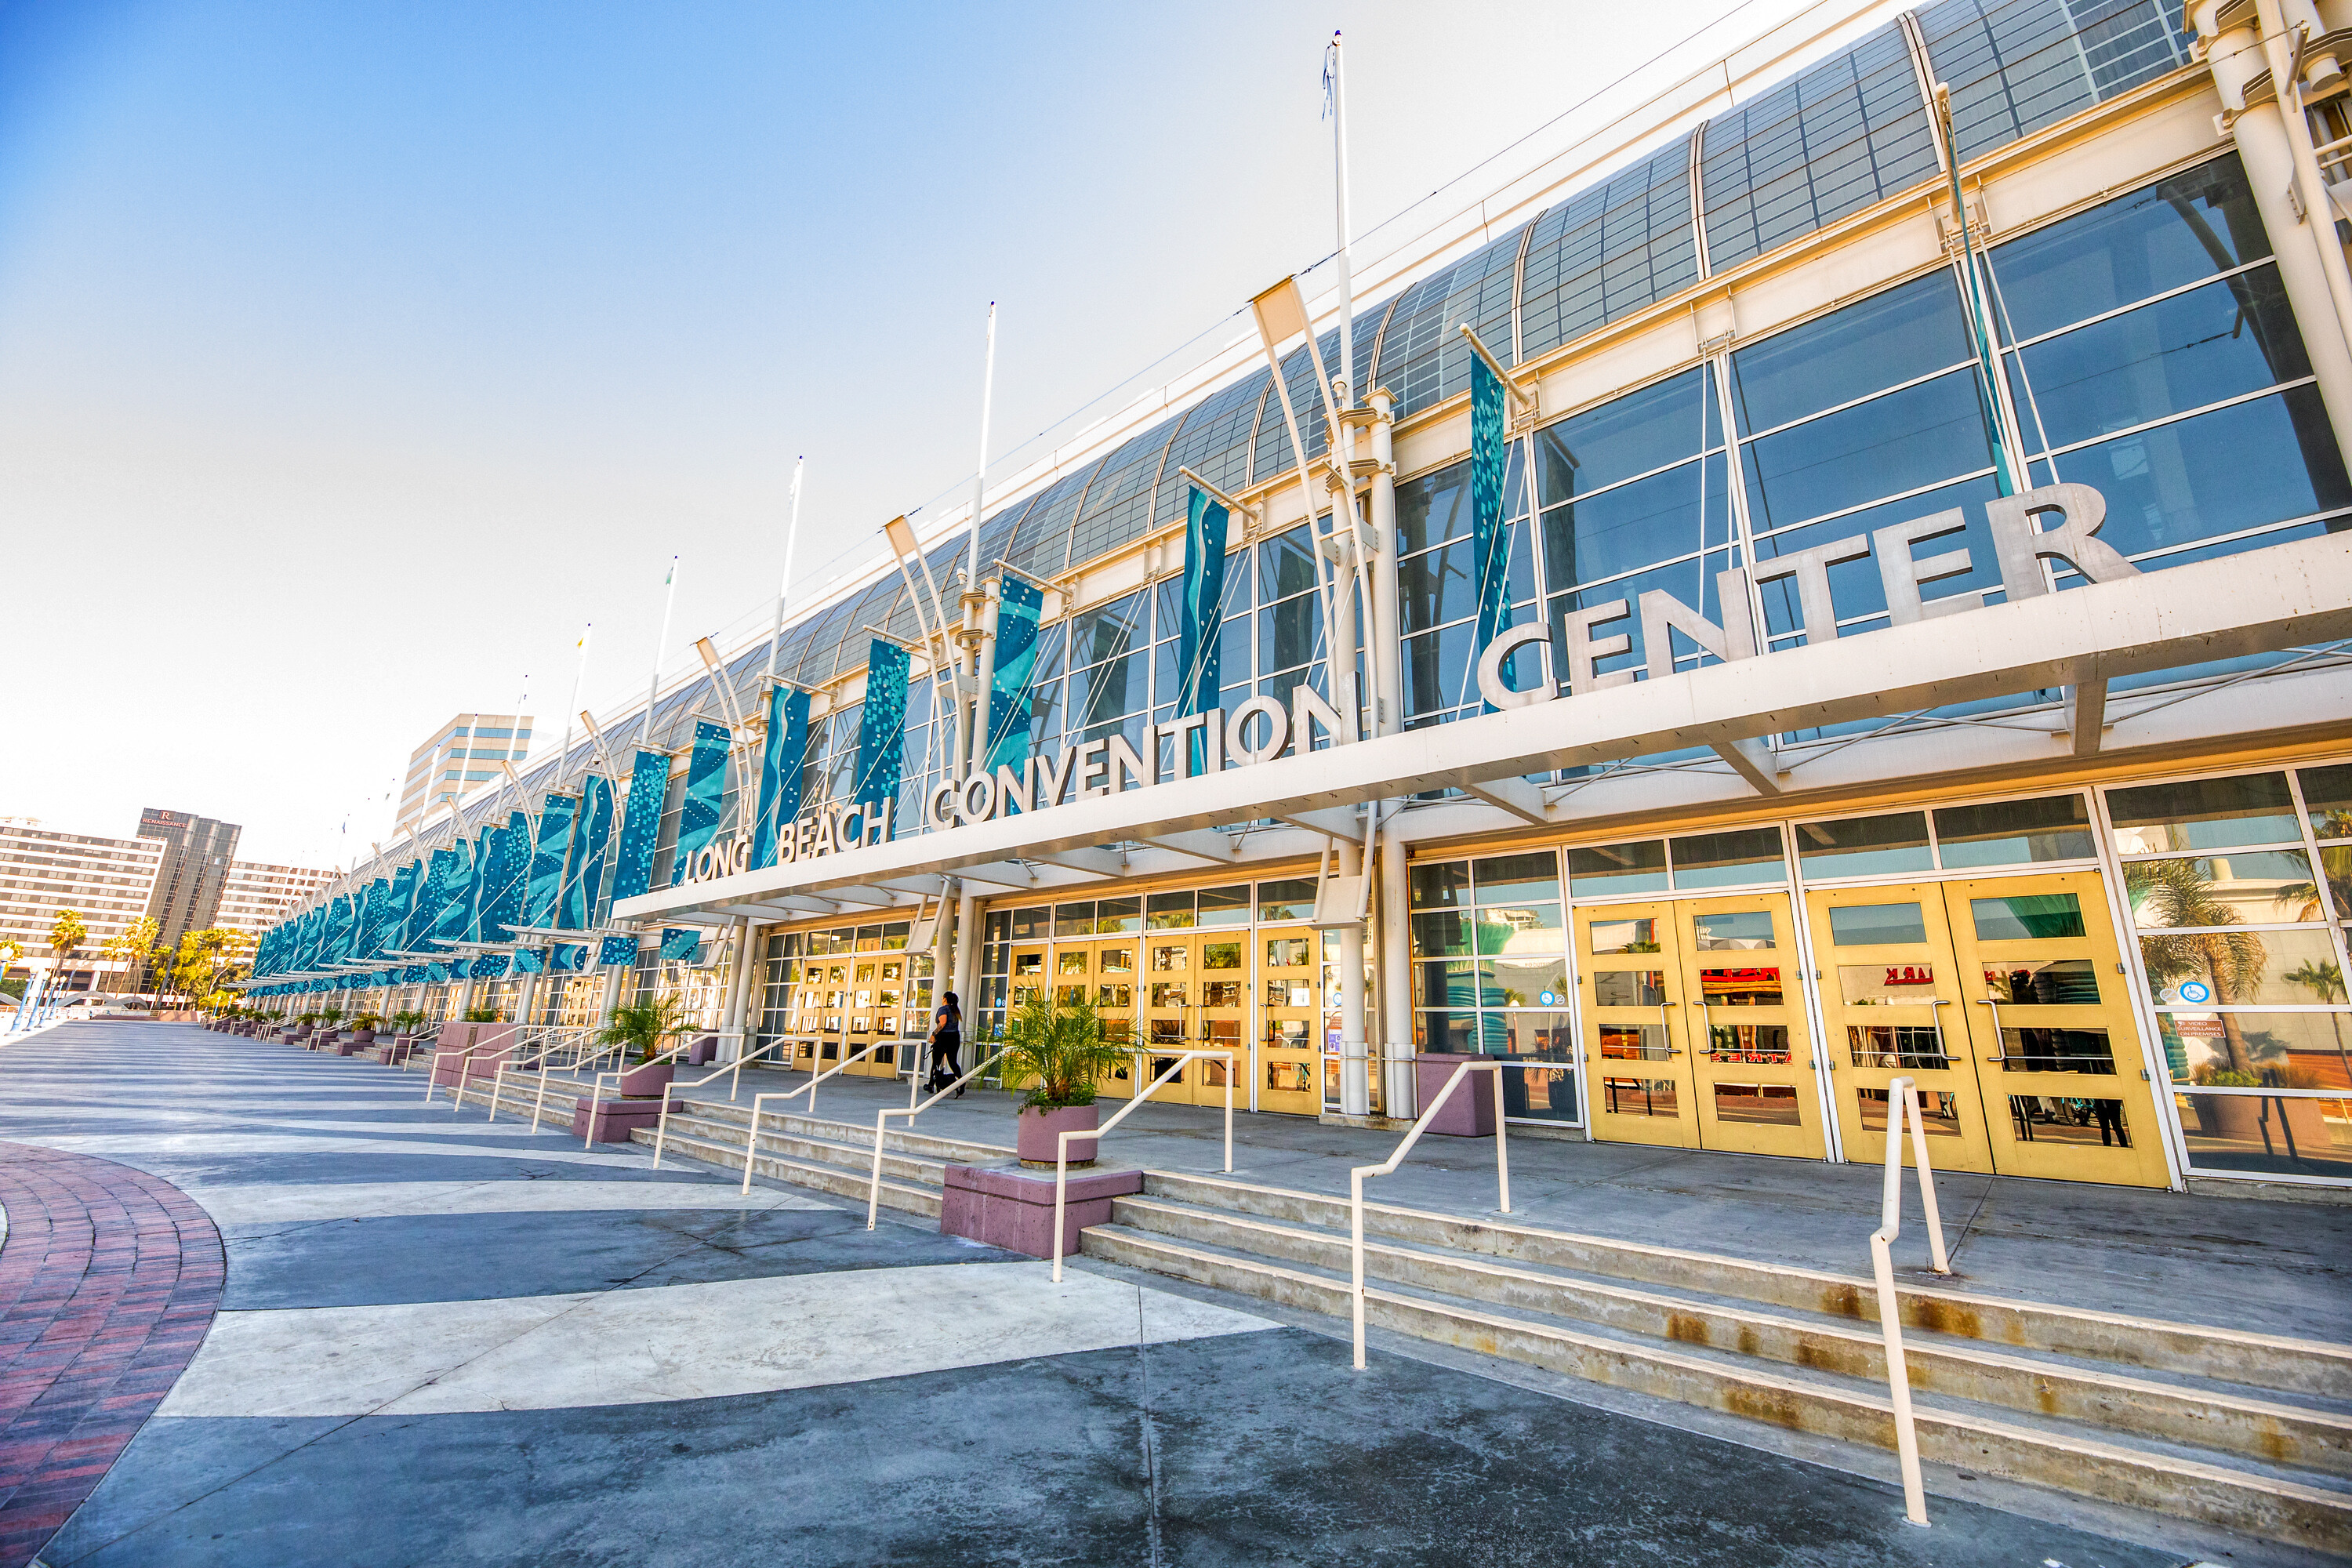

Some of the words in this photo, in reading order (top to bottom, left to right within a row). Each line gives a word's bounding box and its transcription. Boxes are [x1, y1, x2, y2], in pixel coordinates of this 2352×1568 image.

[684, 834, 752, 884] LONG
[777, 797, 895, 866] BEACH
[927, 671, 1363, 832] CONVENTION
[1477, 482, 2143, 711] CENTER
[142, 818, 187, 828] RENAISSANCE
